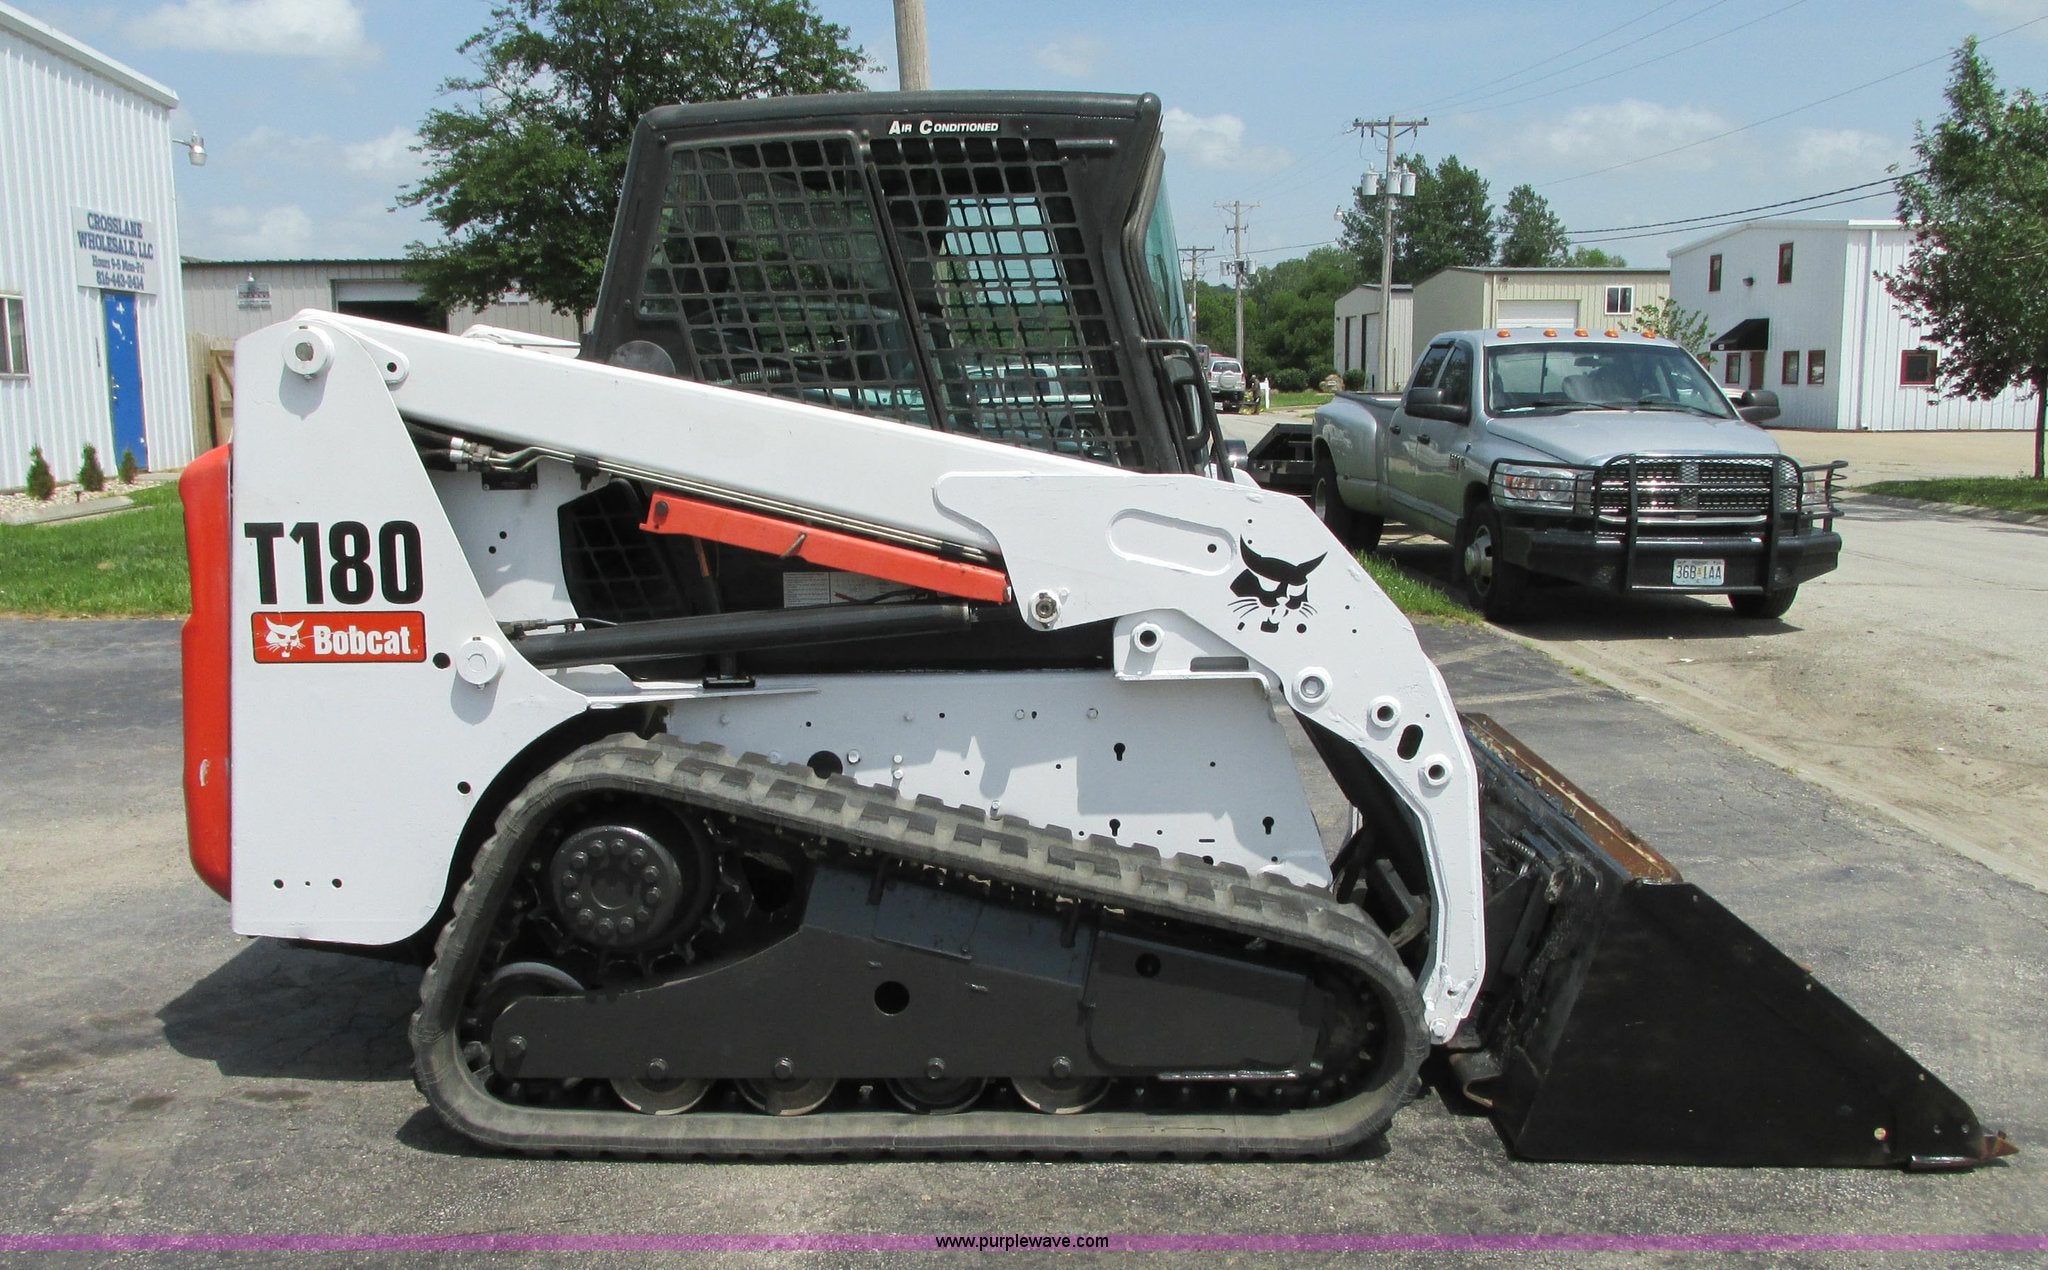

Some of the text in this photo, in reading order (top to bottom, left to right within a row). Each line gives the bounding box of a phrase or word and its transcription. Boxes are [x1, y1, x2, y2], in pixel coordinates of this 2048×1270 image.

[87, 212, 144, 239] CROSSLANE
[77, 231, 154, 260] WHOLESALE, LLC
[244, 520, 424, 605] T180
[313, 625, 412, 655] Bobcat
